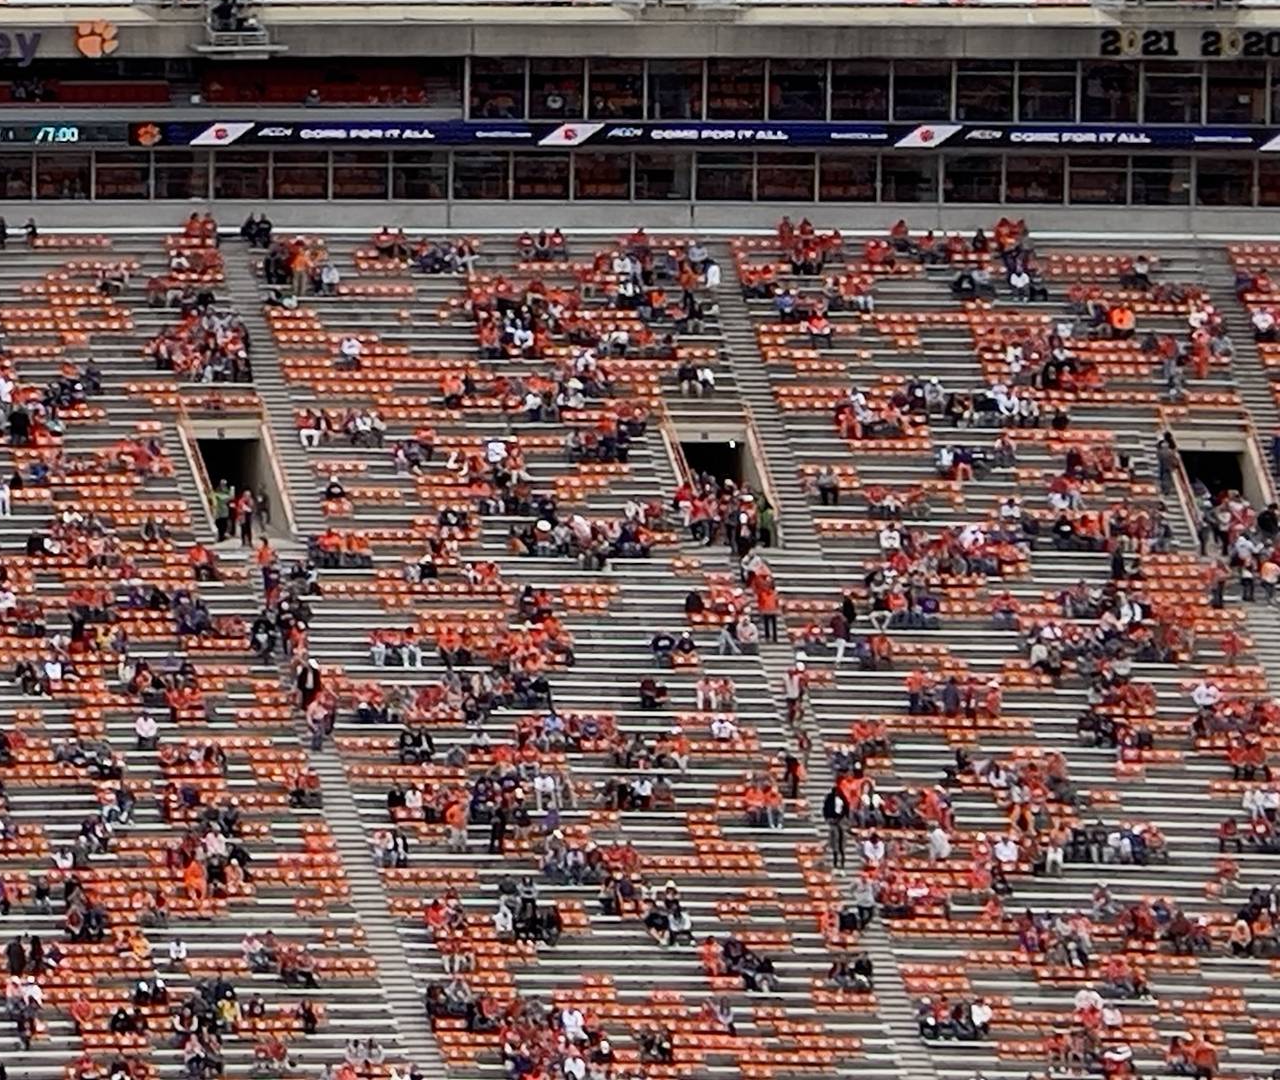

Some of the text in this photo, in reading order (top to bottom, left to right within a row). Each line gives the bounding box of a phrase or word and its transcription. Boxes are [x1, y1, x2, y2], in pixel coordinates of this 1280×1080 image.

[402, 128, 436, 139] ALL
[755, 129, 789, 139] ALL
[1117, 132, 1152, 143] ALL
